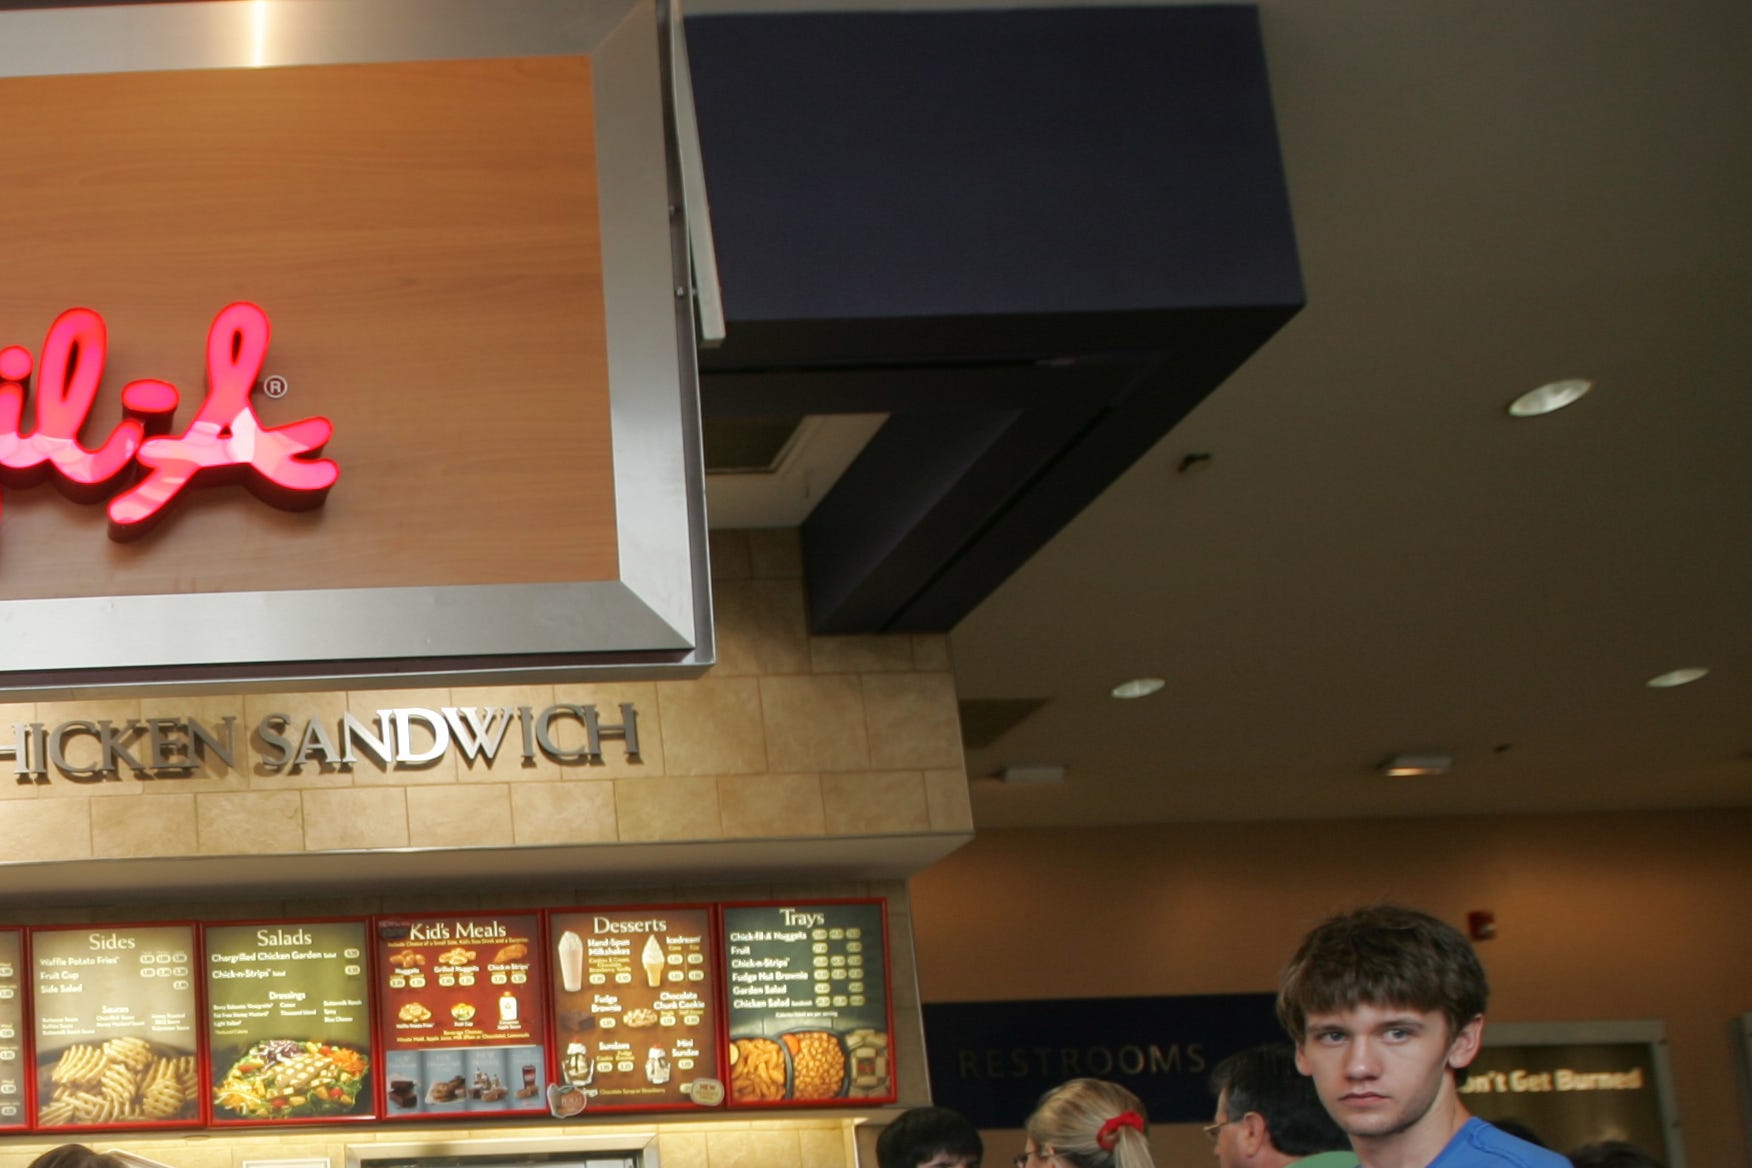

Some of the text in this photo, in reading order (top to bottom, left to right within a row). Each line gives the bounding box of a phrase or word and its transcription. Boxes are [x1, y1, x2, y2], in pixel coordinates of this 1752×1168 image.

[257, 702, 640, 769] SANDWICH
[779, 908, 824, 928] Trays
[410, 923, 450, 940] Kid's
[455, 921, 506, 938] Meals
[594, 917, 667, 934] Desserts
[89, 933, 136, 950] Sides
[257, 929, 312, 947] Salads
[774, 932, 807, 942] Nuggets
[40, 957, 66, 966] Waffle
[68, 957, 95, 965] Potato
[212, 953, 256, 964] Chargrilled
[257, 952, 290, 961] Chicken
[292, 951, 322, 960] Garden
[40, 971, 79, 980] Fruit Cup
[732, 971, 808, 983] Fudge Nut Brownie
[40, 984, 82, 993] Side Salad
[733, 985, 787, 995] Garden Salad
[269, 991, 306, 1001] Dressings
[594, 994, 618, 1005] Fudge
[660, 992, 697, 1000] Chocolate
[591, 1004, 622, 1012] Brownie
[653, 1000, 705, 1010] Chunk Cookie
[734, 999, 766, 1009] Chicken
[768, 998, 790, 1007] Salad
[676, 1039, 693, 1047] Mini
[672, 1048, 699, 1057] Sundae
[958, 1043, 1206, 1080] RESTROOMS
[1510, 1067, 1643, 1092] Get Burned
